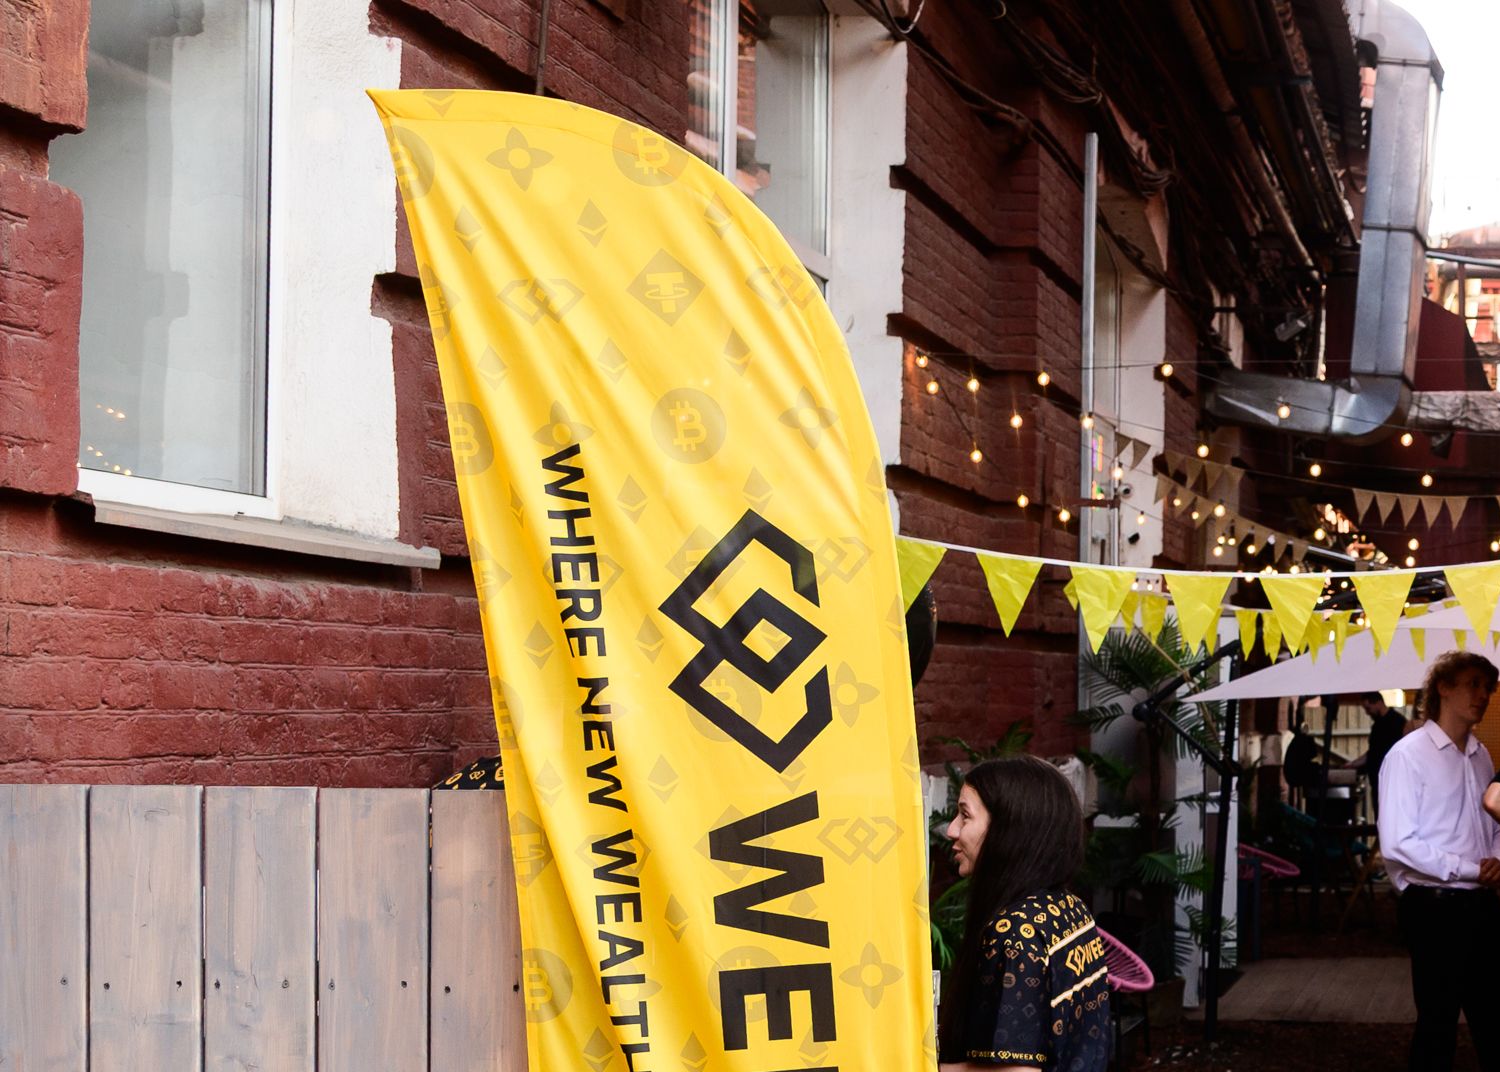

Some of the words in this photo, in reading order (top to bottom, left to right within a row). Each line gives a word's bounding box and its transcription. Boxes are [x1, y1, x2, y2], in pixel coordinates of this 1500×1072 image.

[541, 443, 607, 659] WHERE
[577, 677, 629, 813] NEW
[1012, 1052, 1034, 1060] WEEX
